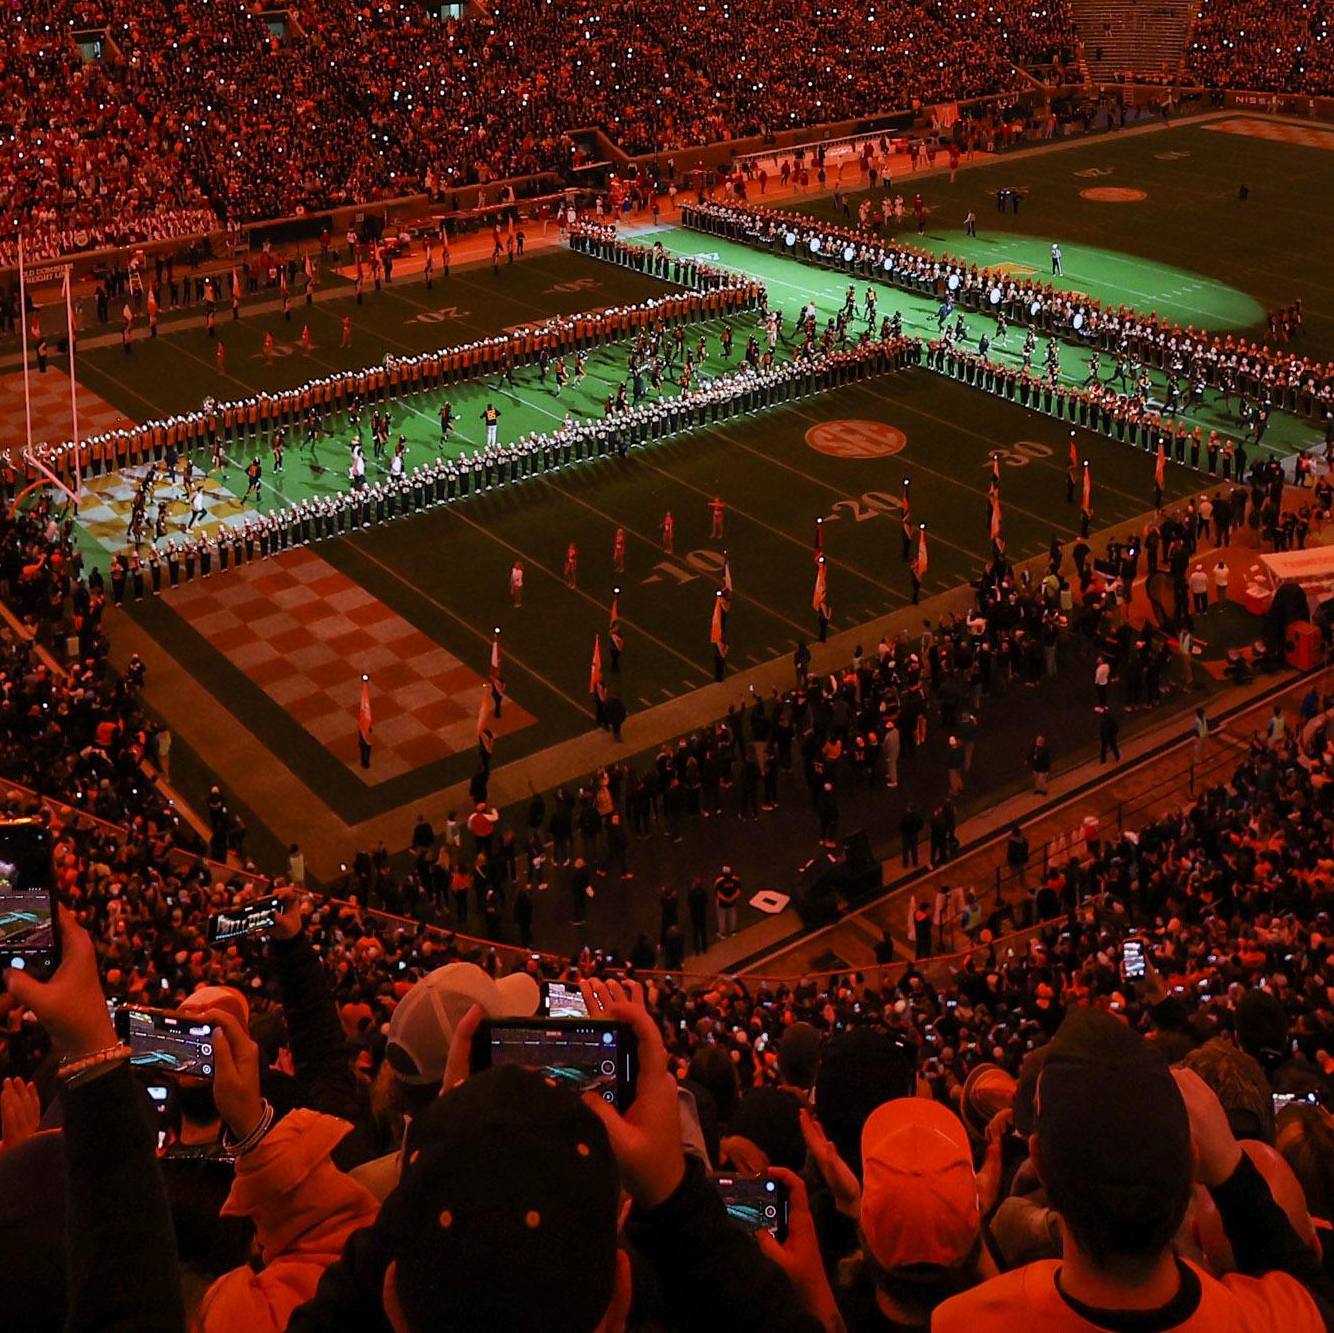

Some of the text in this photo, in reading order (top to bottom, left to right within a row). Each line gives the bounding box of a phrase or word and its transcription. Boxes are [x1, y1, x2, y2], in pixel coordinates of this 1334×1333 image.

[1235, 95, 1284, 106] NISSN
[997, 440, 1055, 468] 30
[831, 490, 905, 524] 20
[658, 547, 726, 586] 10
